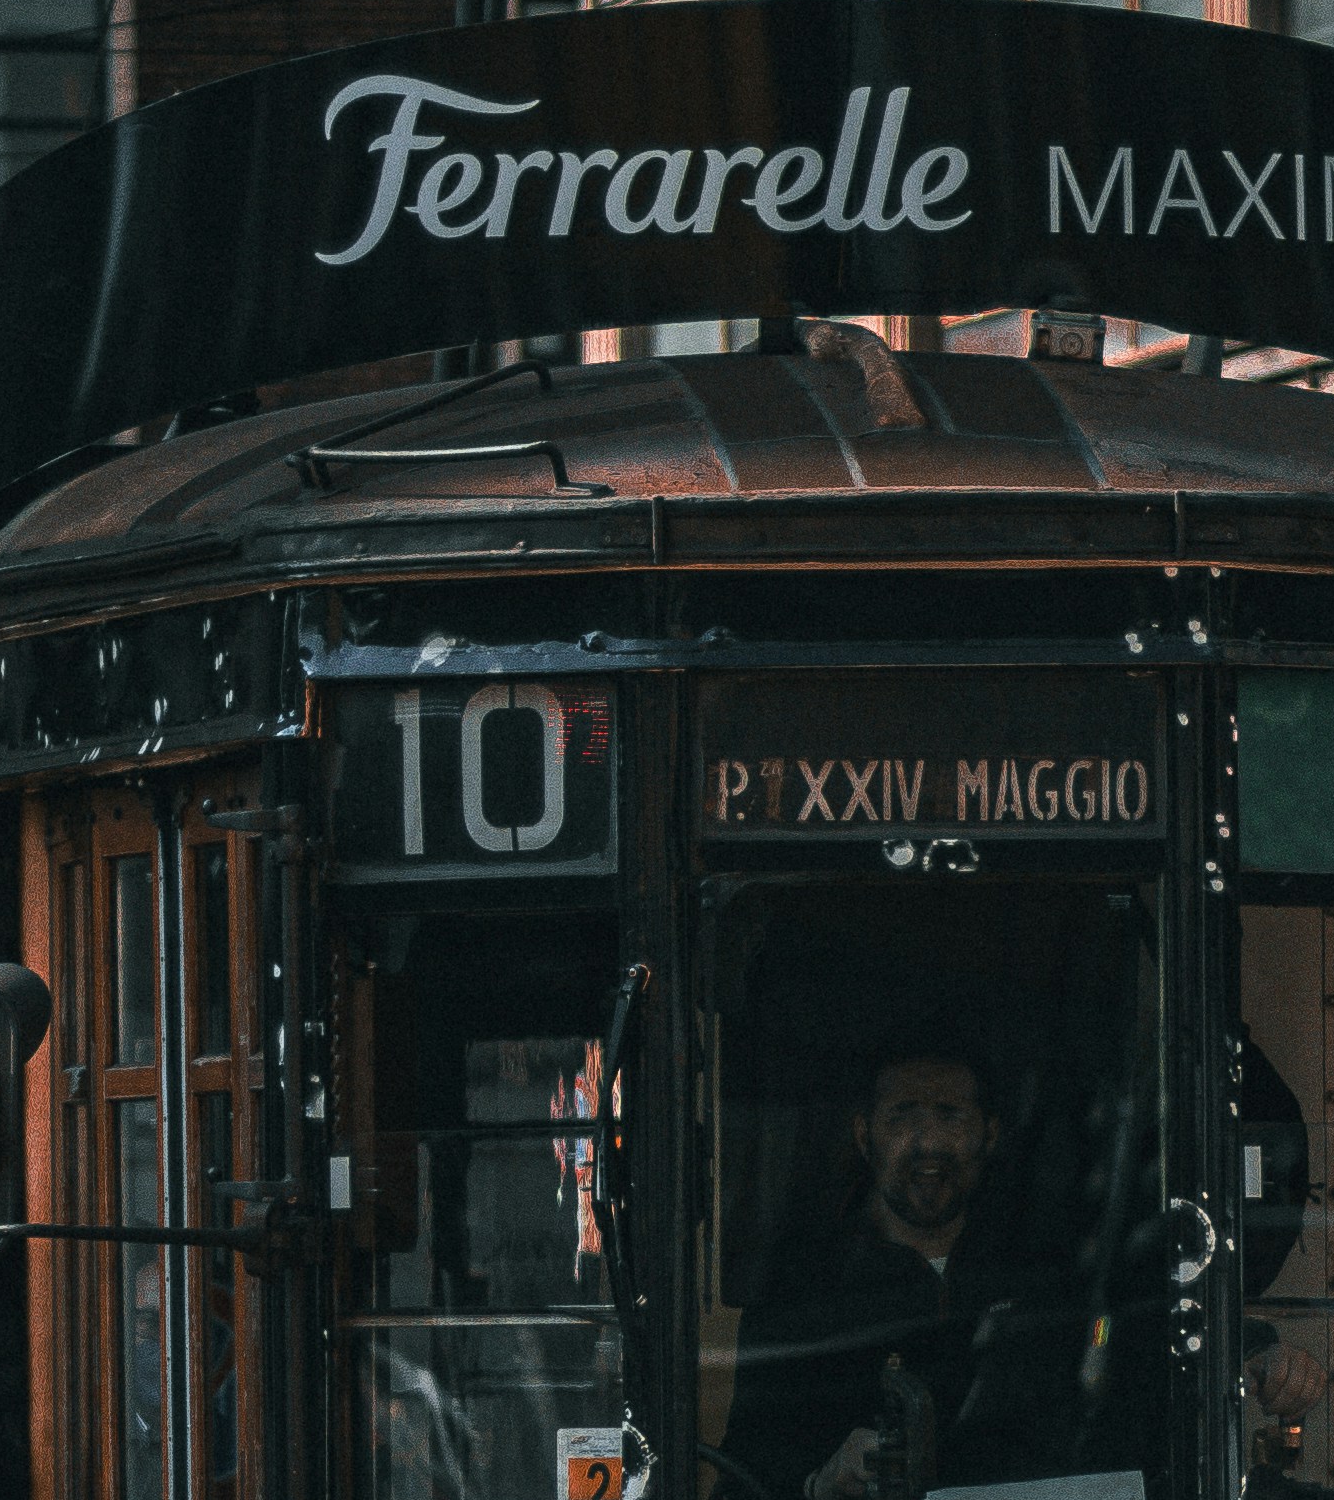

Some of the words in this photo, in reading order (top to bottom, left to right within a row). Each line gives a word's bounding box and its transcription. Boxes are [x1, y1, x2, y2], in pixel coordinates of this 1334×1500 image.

[315, 75, 973, 266] Ferrarelle
[393, 683, 565, 856] 10
[798, 760, 924, 822] XXIV
[956, 759, 1148, 822] MAGGIO
